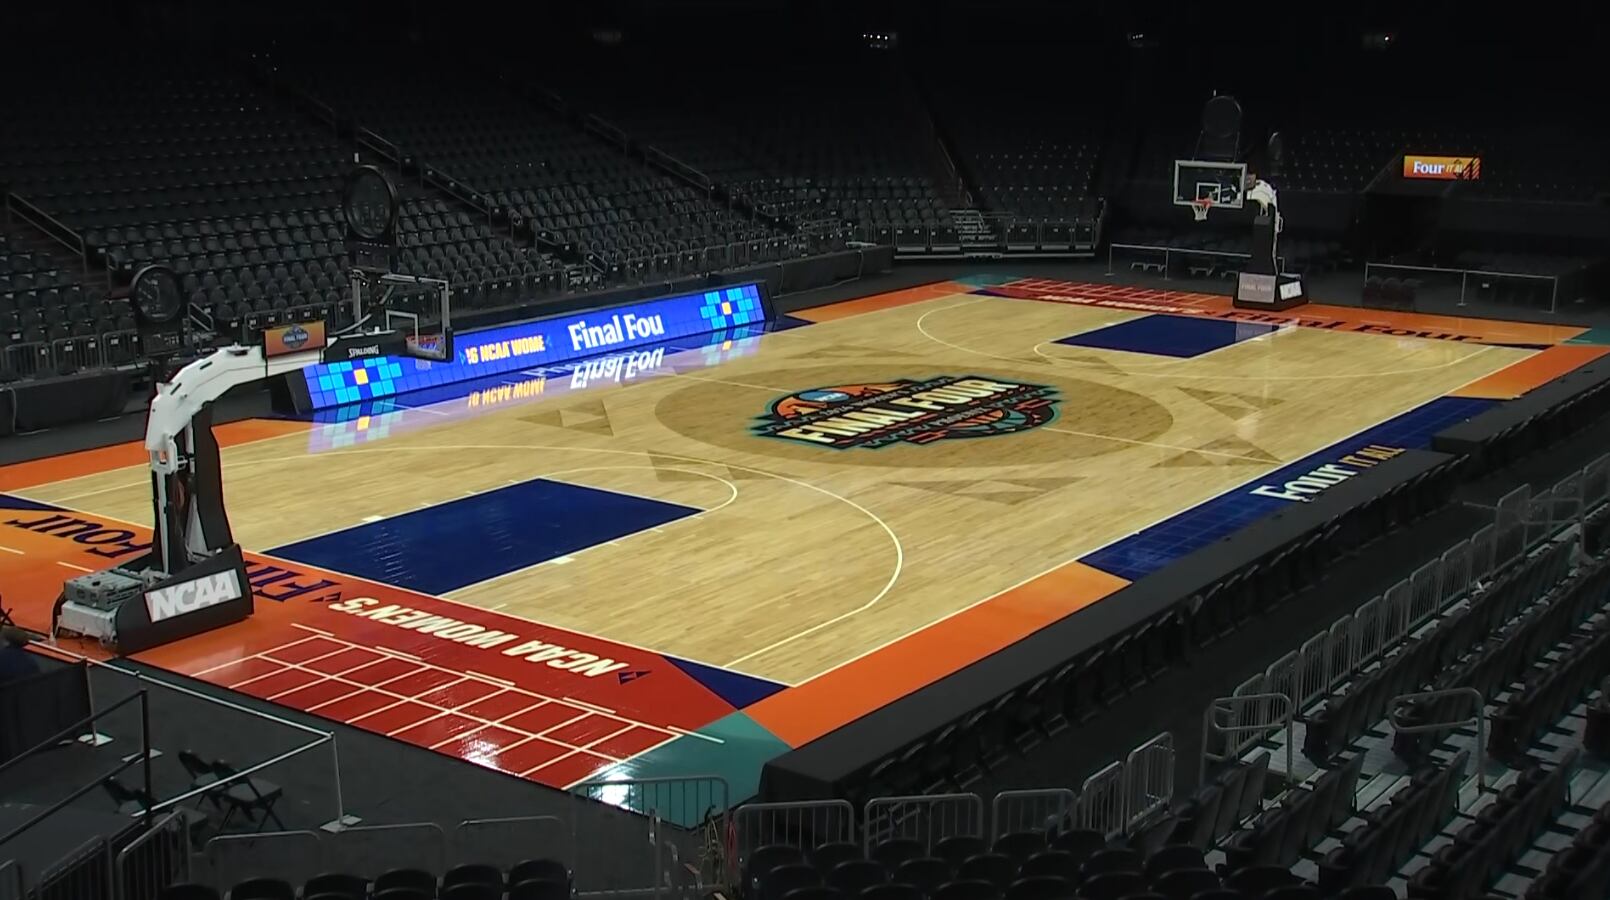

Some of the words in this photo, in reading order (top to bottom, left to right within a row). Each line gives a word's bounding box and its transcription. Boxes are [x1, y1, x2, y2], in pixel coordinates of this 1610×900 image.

[1413, 160, 1445, 175] Four
[348, 344, 379, 358] SPALDING
[479, 341, 511, 363] NCAA
[510, 335, 546, 356] WOME
[567, 314, 625, 351] Final
[622, 313, 665, 340] Fou
[1352, 324, 1483, 341] Four
[776, 407, 928, 444] FINAL
[888, 379, 1020, 411] FOUR
[1249, 463, 1359, 502] Four
[2, 514, 153, 559] Four
[149, 571, 236, 622] NCAA
[327, 597, 520, 650] WOMEN'S
[501, 640, 630, 678] NCAA
